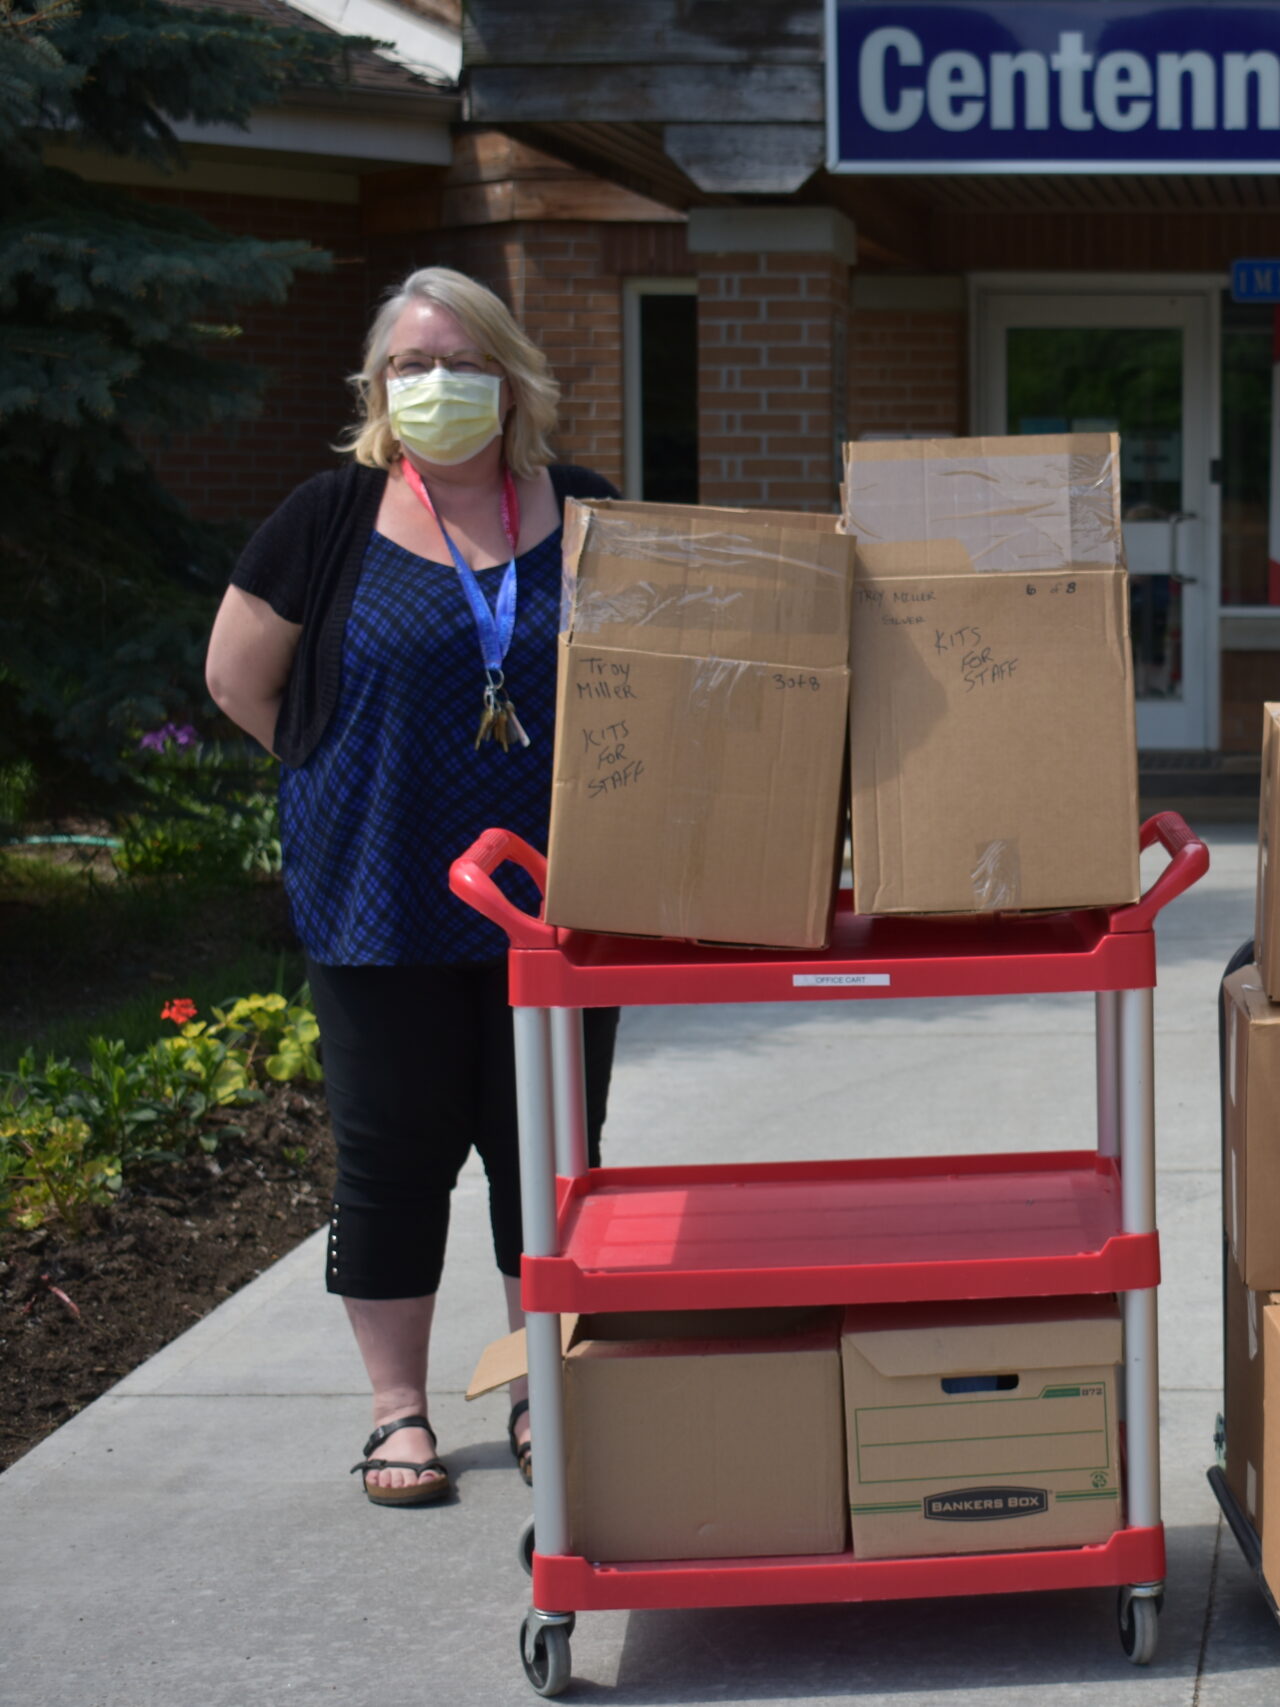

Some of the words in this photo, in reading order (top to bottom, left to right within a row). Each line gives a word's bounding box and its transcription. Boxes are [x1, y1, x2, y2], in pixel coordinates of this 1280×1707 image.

[1253, 269, 1273, 294] M
[1026, 583, 1037, 596] 6
[1066, 581, 1077, 594] 8
[934, 625, 982, 656] KITS
[578, 657, 630, 682] Troy
[960, 646, 995, 673] FOR
[963, 657, 1019, 693] STAFF
[581, 719, 630, 753] KITS
[597, 743, 628, 770] FOR
[587, 760, 646, 799] STAFF
[815, 976, 843, 984] OFFICE
[845, 976, 866, 984] CART
[931, 1497, 1004, 1513] BANKERS
[1007, 1495, 1041, 1509] BOX
